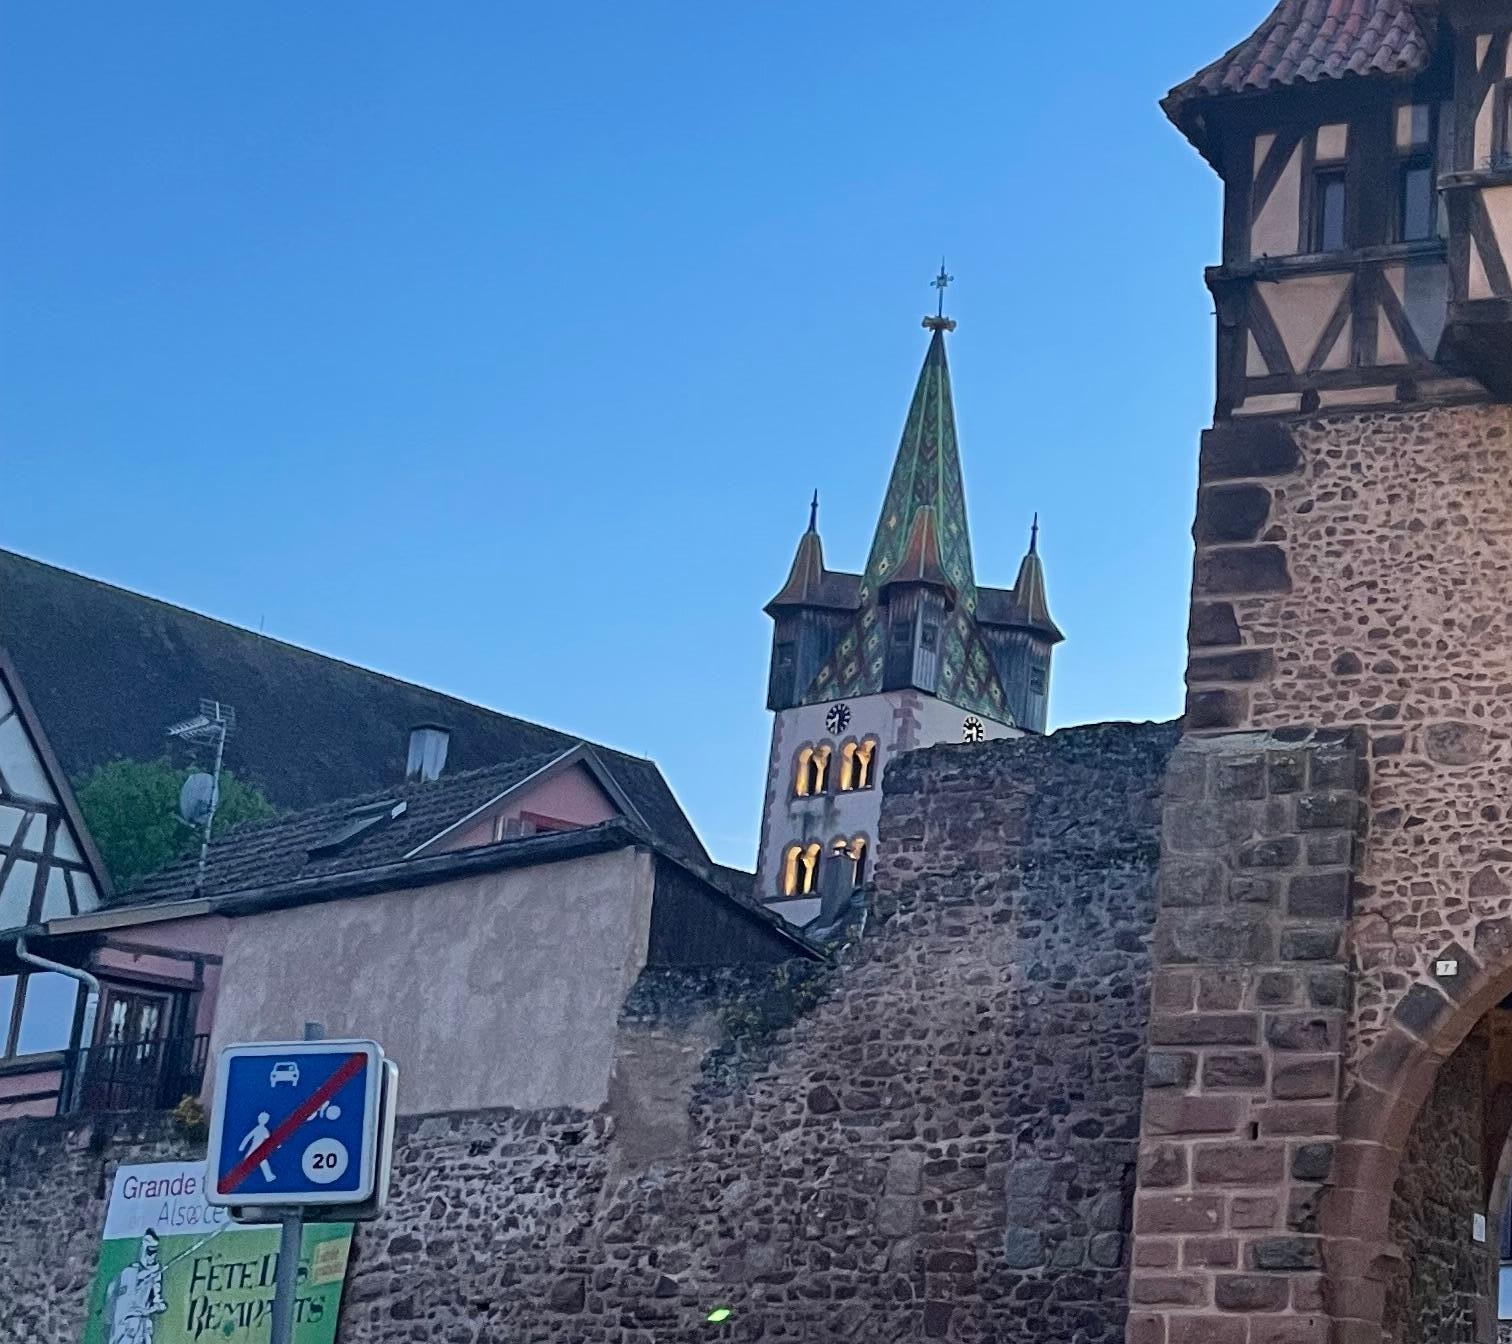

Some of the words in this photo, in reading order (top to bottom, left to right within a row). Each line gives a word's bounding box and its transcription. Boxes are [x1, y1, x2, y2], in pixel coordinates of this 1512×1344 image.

[312, 1152, 338, 1170] 20
[123, 1171, 196, 1199] Grande
[157, 1197, 224, 1226] Alsace
